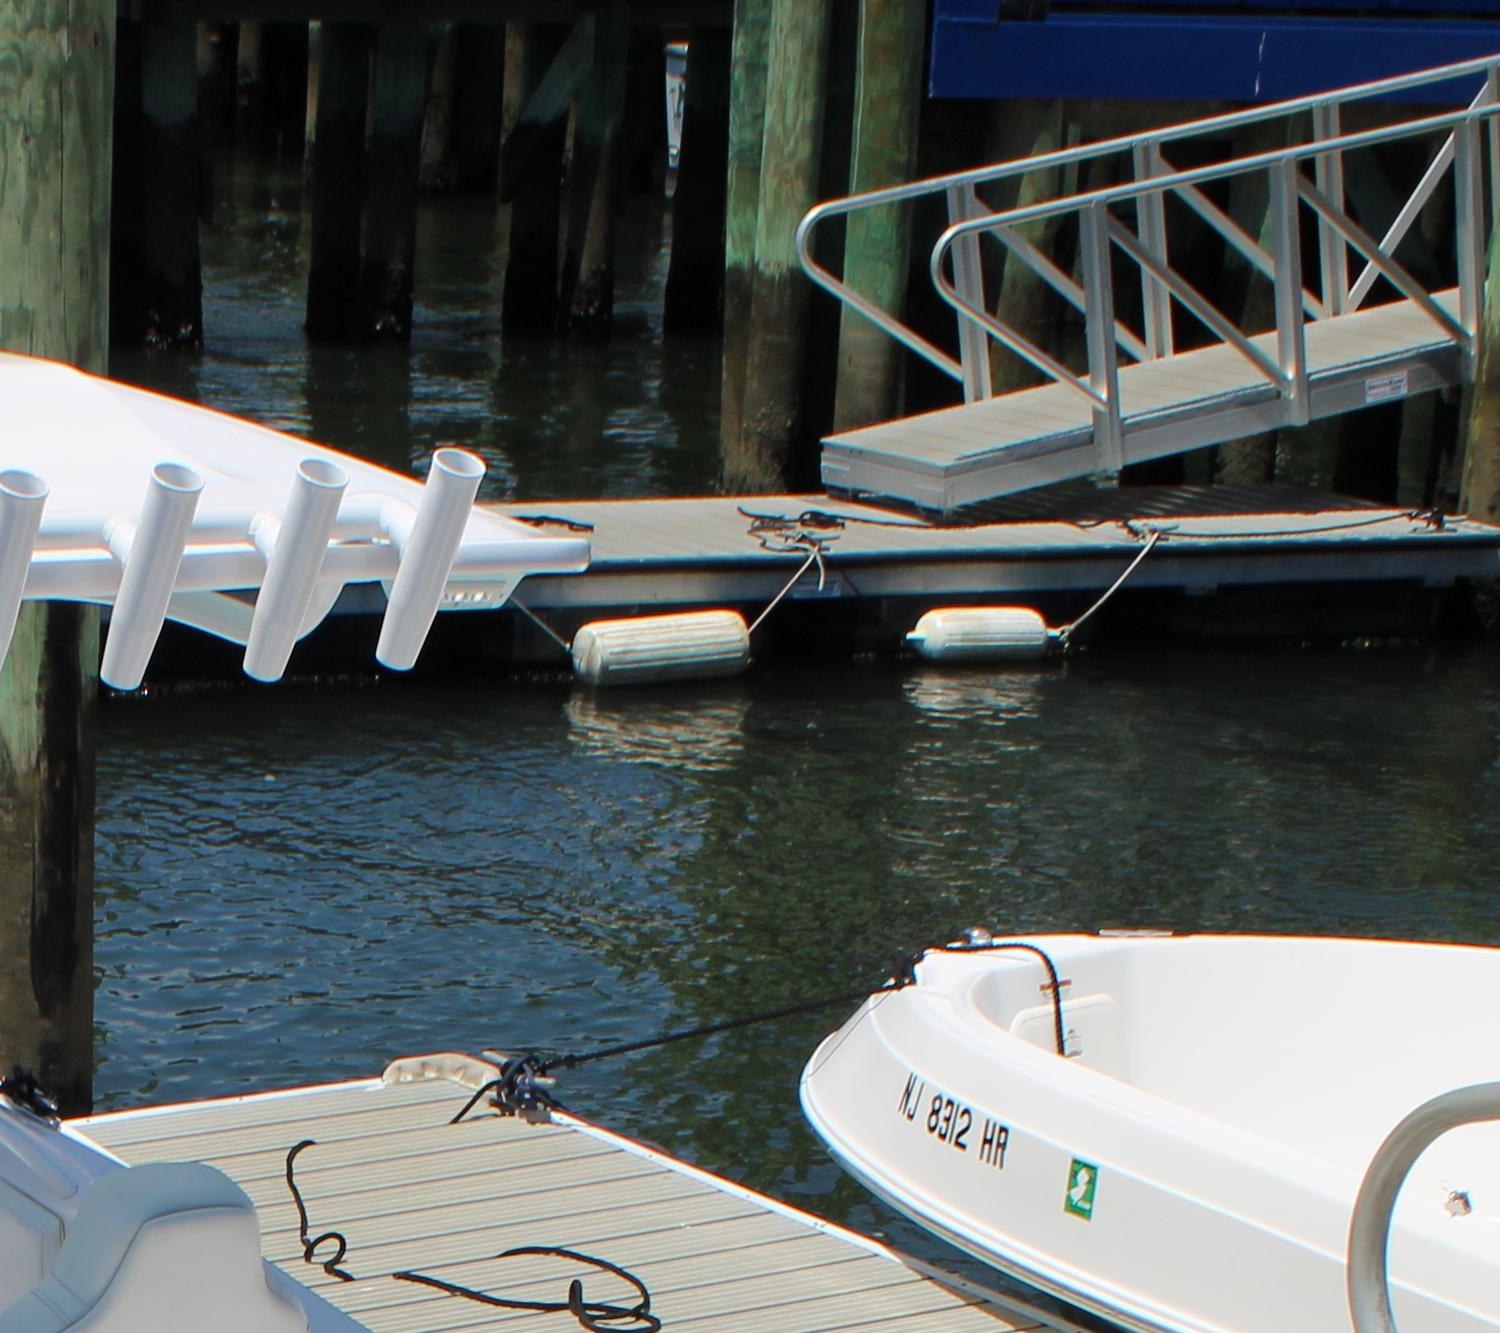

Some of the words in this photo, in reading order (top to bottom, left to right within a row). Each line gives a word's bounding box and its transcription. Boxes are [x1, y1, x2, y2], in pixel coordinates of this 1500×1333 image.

[898, 1071, 925, 1122] NJ
[927, 1093, 973, 1152] 8312
[978, 1118, 1010, 1170] HR
